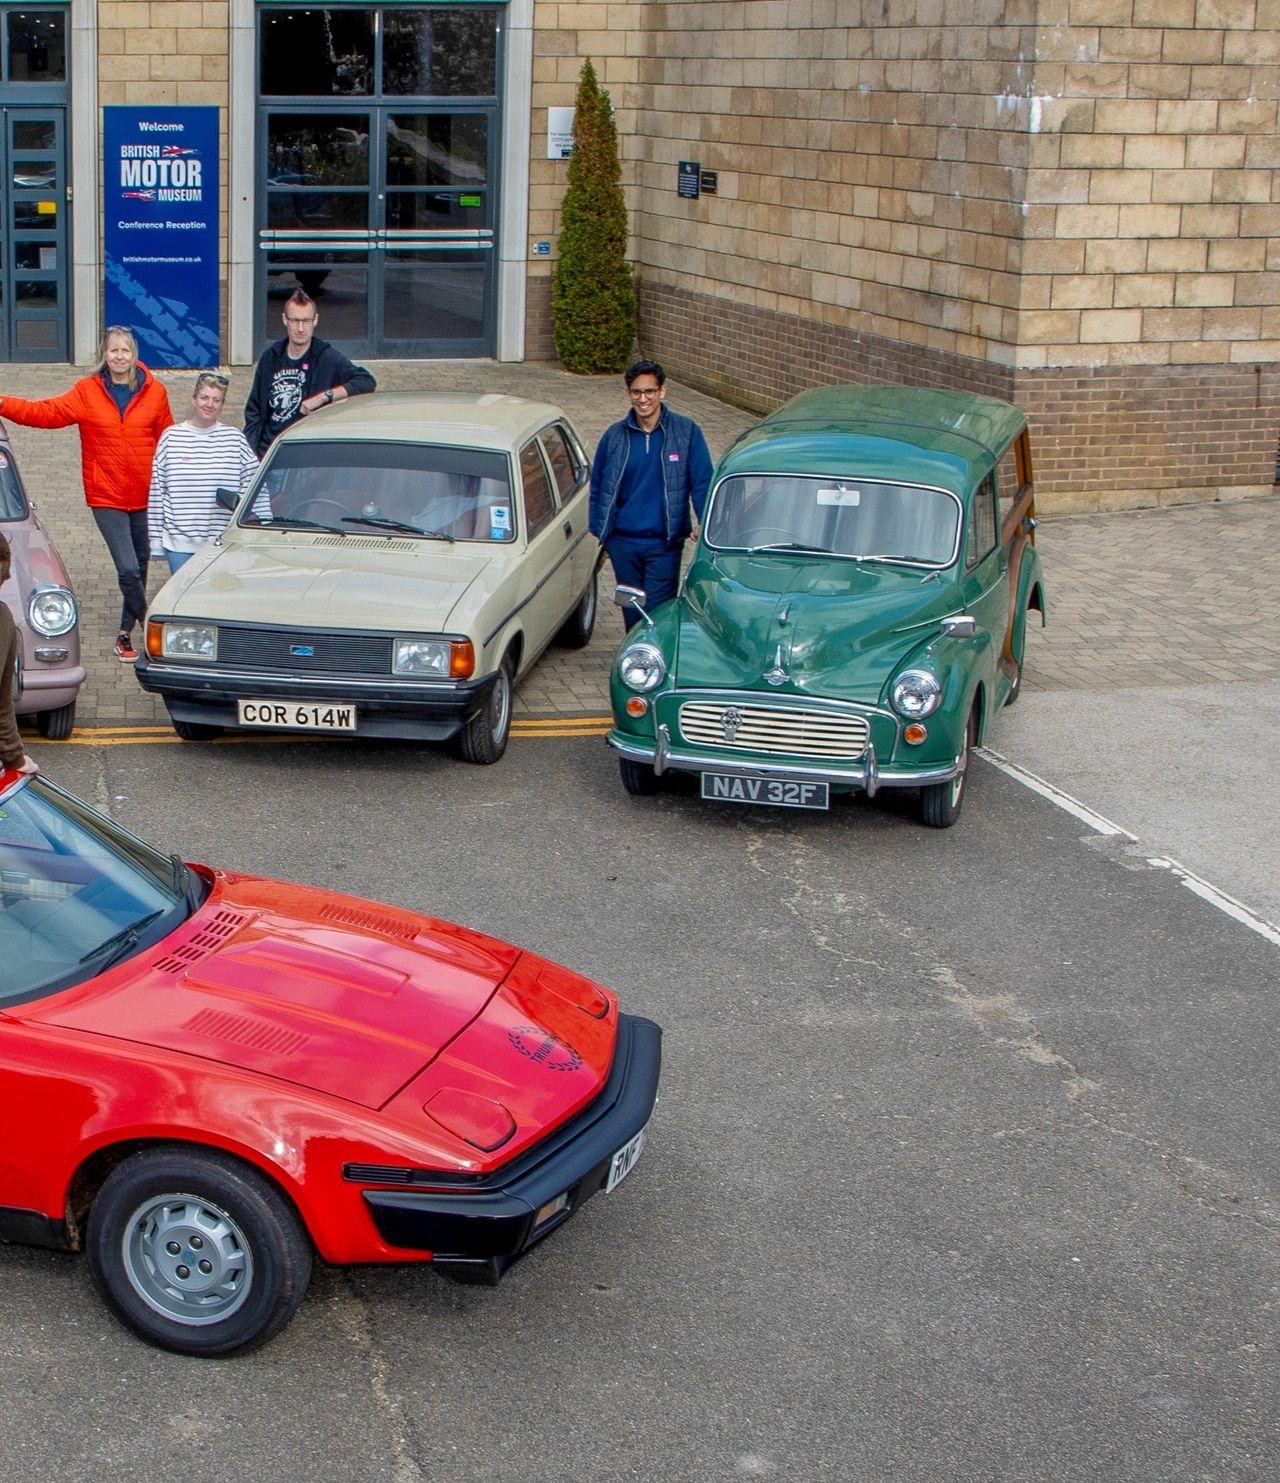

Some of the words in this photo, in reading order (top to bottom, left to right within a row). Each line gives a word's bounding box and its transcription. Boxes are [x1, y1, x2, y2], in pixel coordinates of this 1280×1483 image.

[138, 121, 184, 132] Welcome
[120, 145, 160, 158] BRITISH
[120, 159, 202, 187] MOTOR
[158, 189, 202, 201] MUSEUM
[117, 220, 165, 229] Conference
[165, 220, 207, 231] Reception
[122, 255, 202, 263] britishmotormuseum.co.uk
[243, 704, 288, 724] COR
[295, 706, 351, 728] 614W
[713, 776, 762, 800] NAV
[767, 781, 817, 804] 32F
